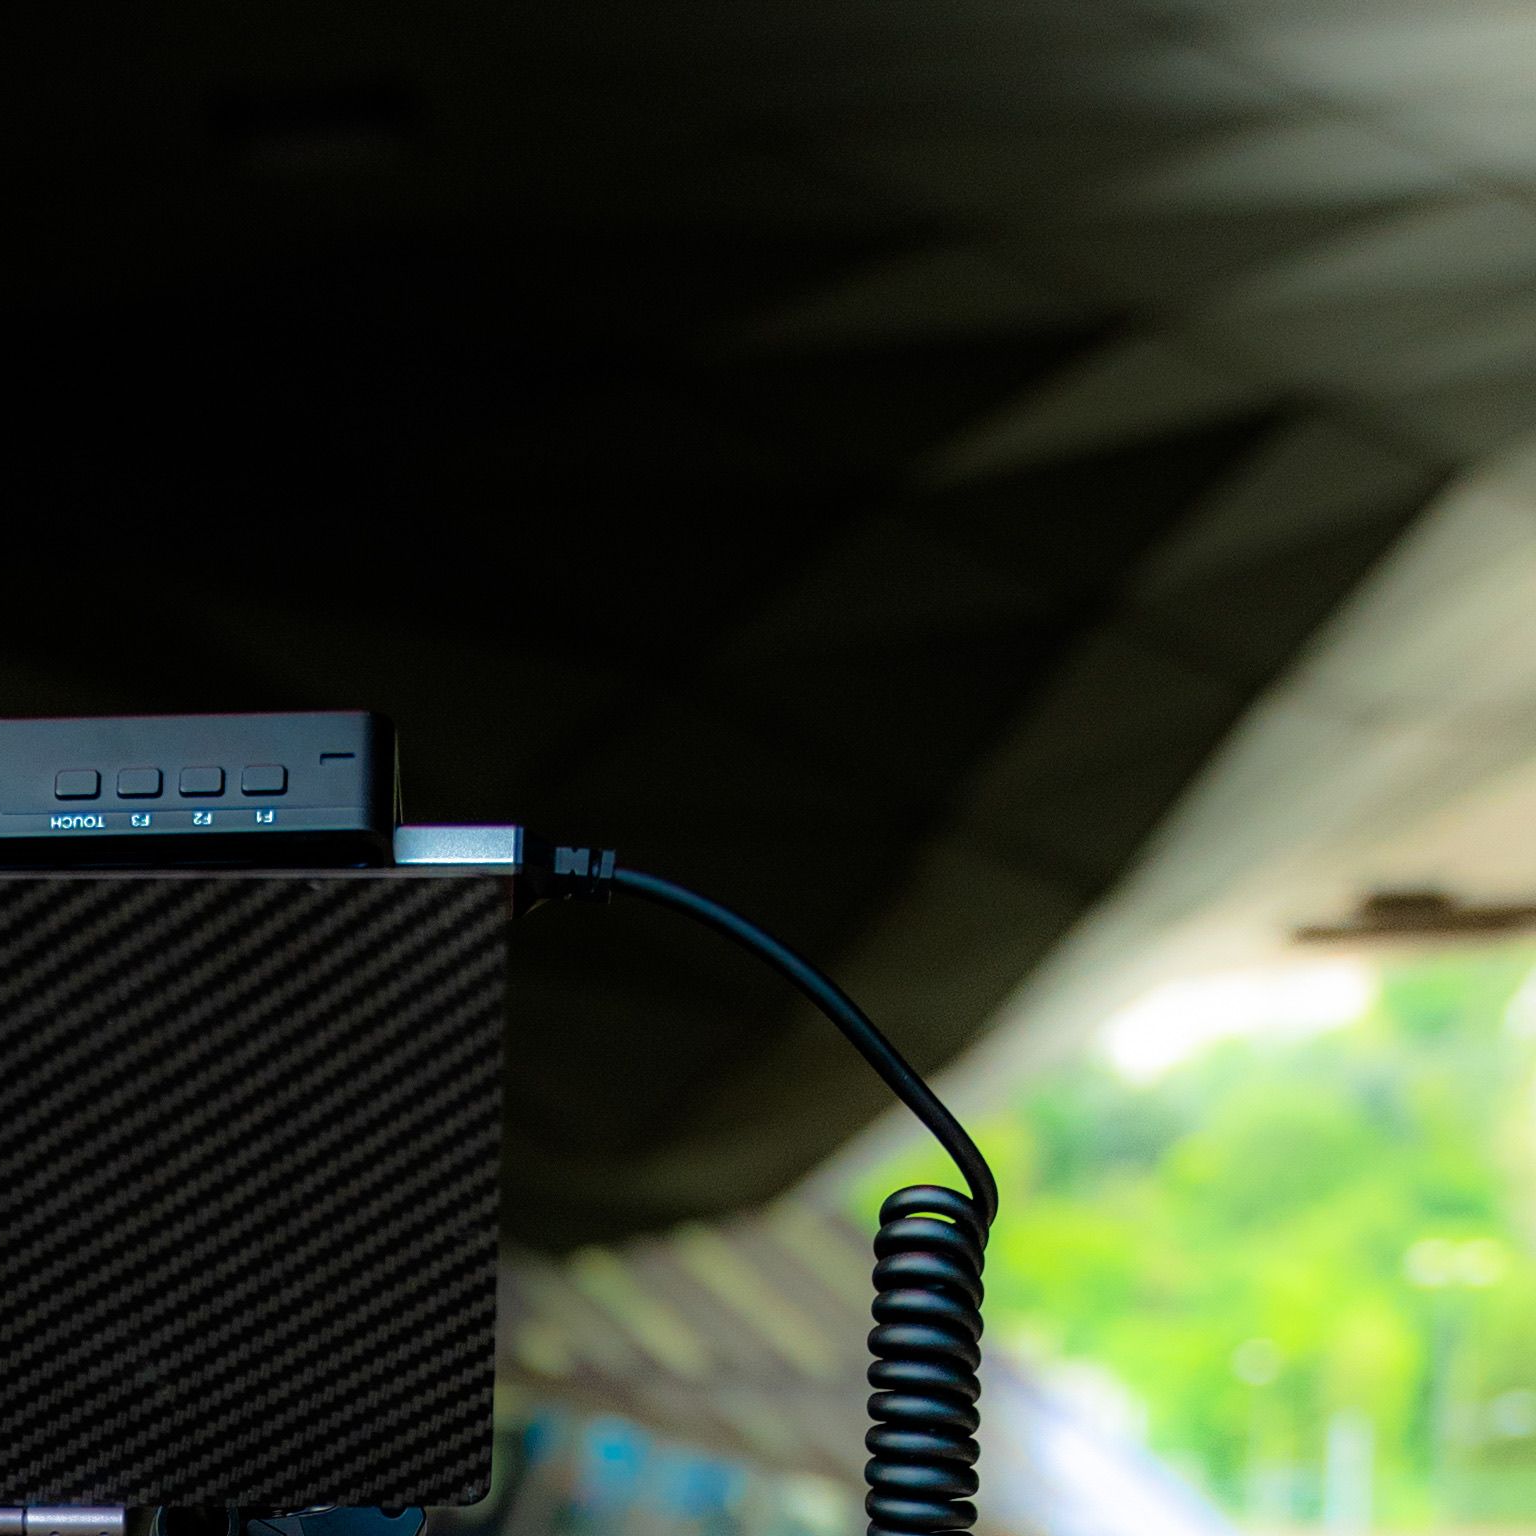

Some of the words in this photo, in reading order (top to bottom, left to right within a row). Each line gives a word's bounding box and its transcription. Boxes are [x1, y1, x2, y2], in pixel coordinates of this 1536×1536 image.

[50, 816, 106, 830] TOUCH
[131, 815, 152, 829] F3
[193, 812, 214, 826] F2
[256, 811, 276, 824] F1
